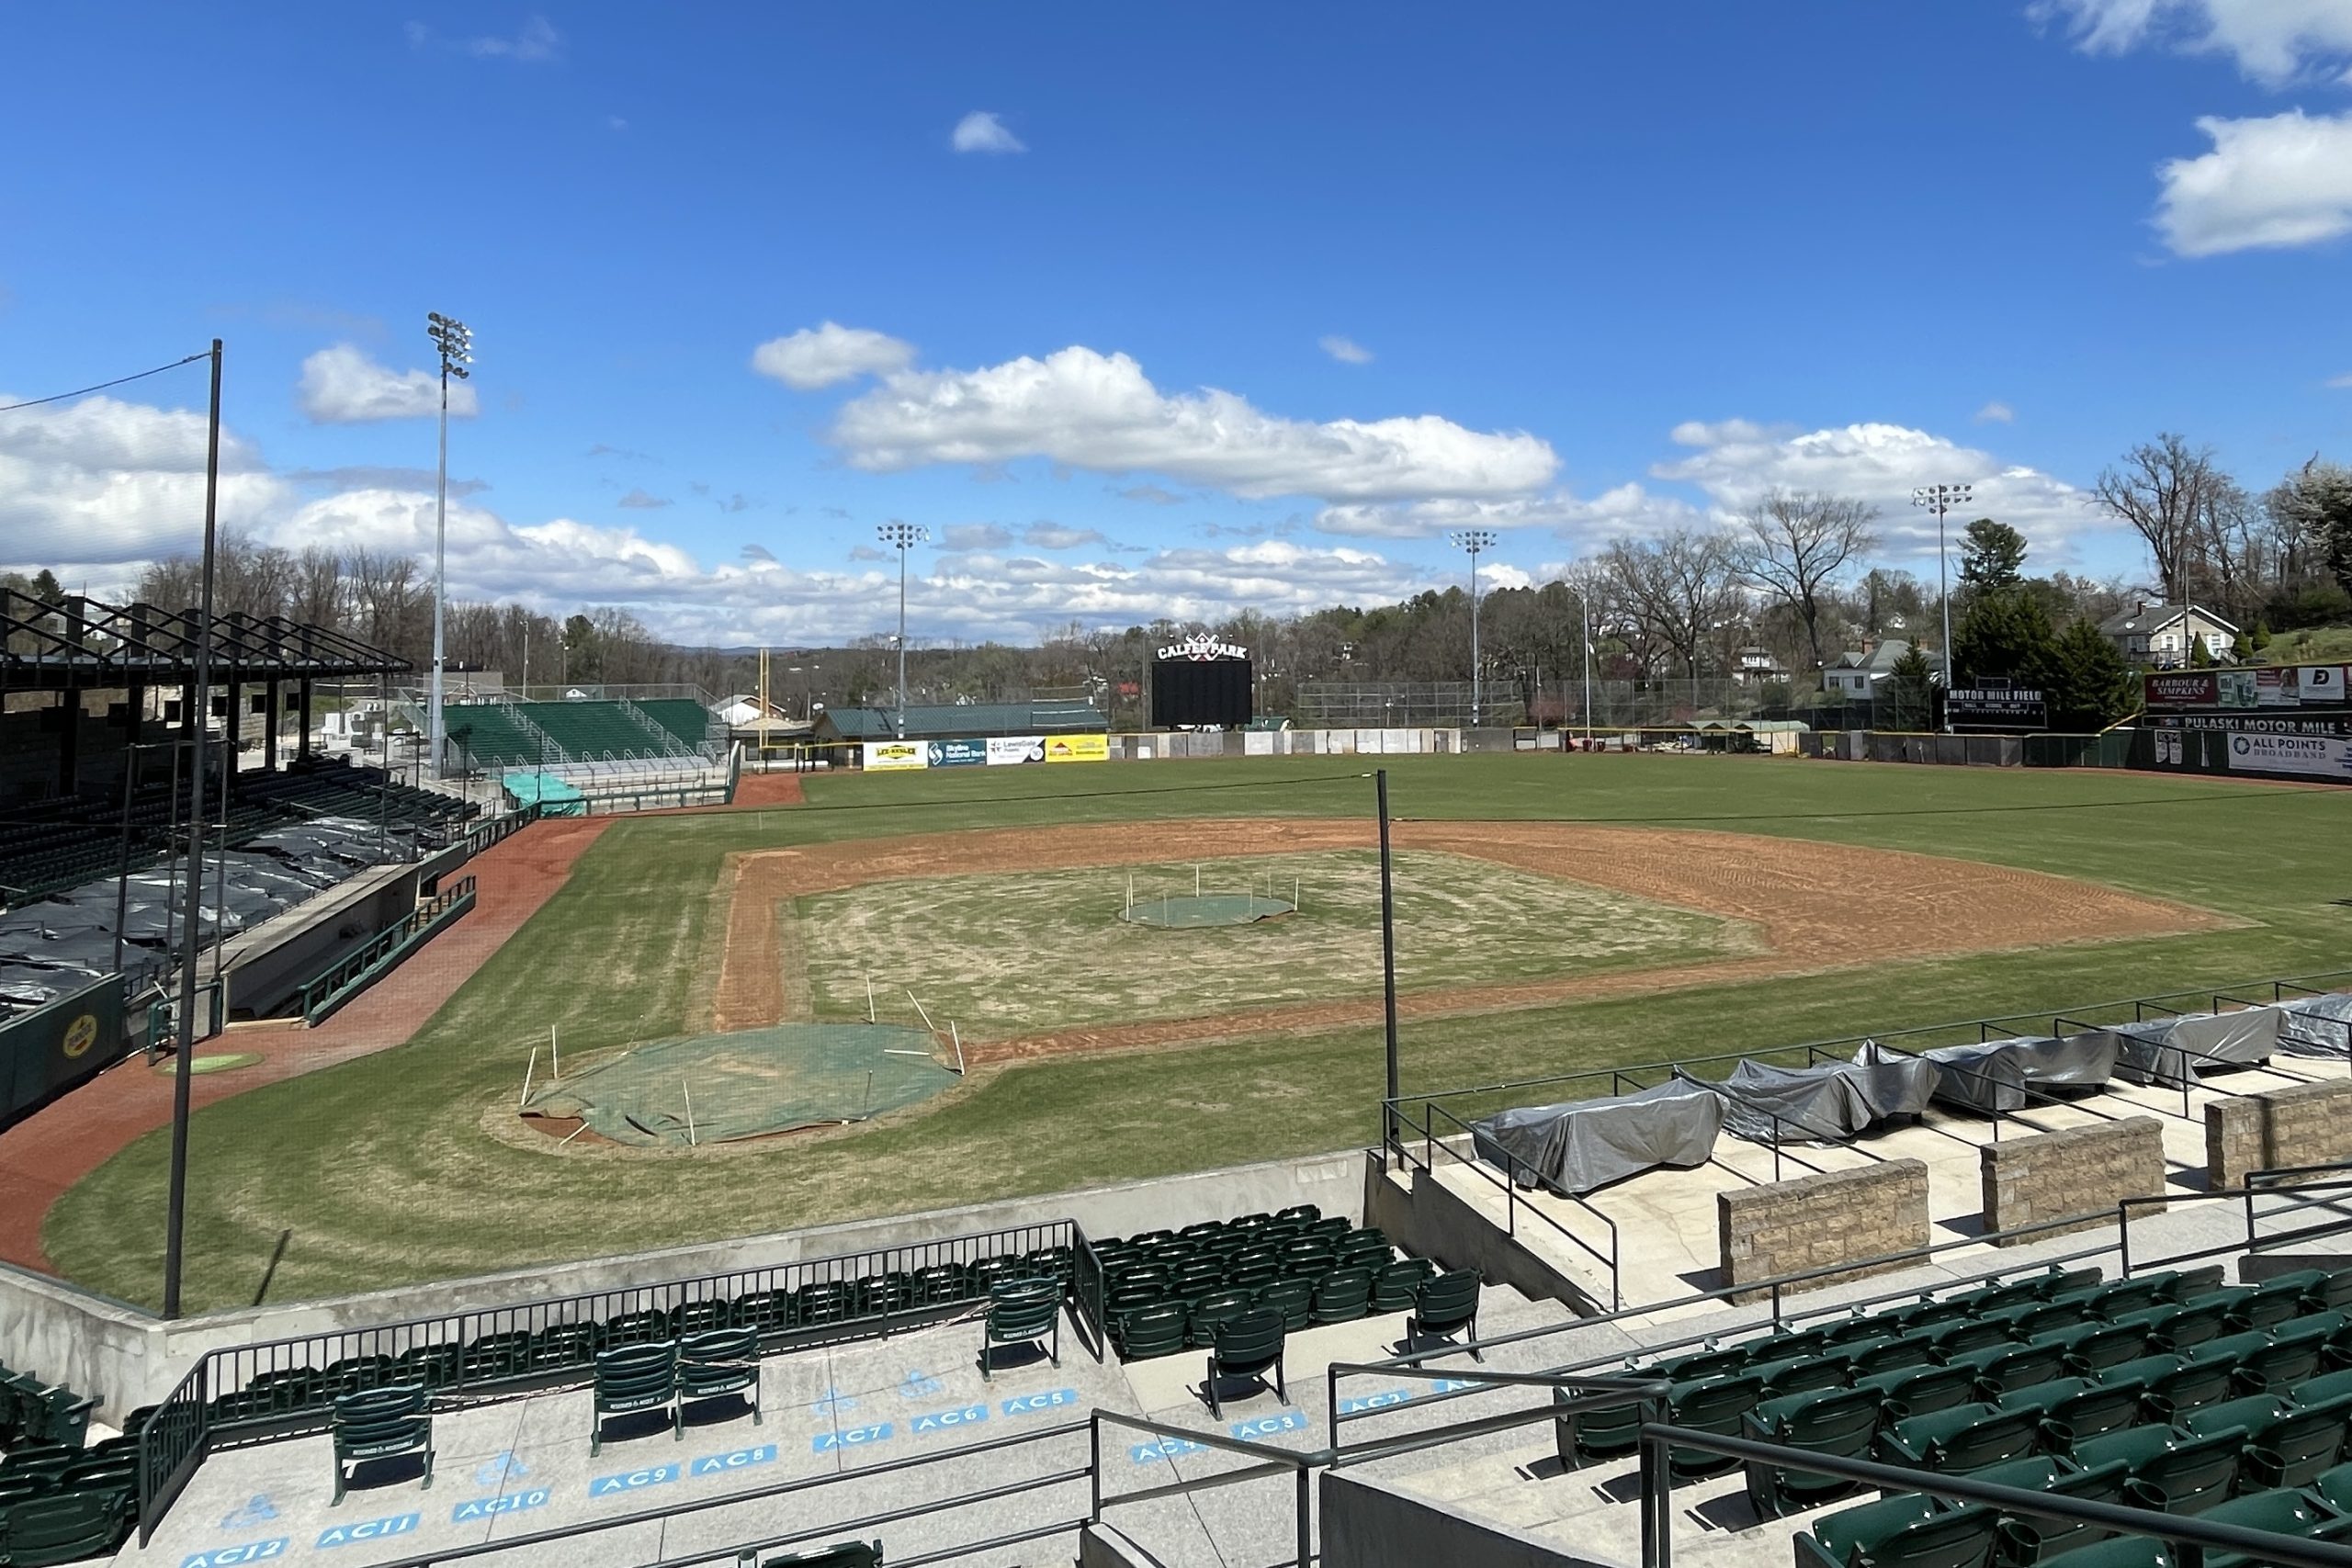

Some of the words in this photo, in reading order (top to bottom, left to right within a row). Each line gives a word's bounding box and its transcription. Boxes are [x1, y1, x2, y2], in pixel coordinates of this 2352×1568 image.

[1158, 642, 1209, 660] CALFEE
[1210, 643, 1248, 659] PARK
[2152, 679, 2199, 688] BARBOUR
[2201, 679, 2210, 688] &
[2156, 687, 2206, 695] SIMPKINS
[1949, 690, 1984, 700] MOTOR
[1986, 691, 2011, 701] MILE
[2013, 690, 2042, 702] FIELD
[2185, 717, 2239, 729] PULASKI
[2244, 719, 2297, 733] MOTOR
[2301, 722, 2335, 734] MILE
[945, 744, 969, 752] Skyline
[945, 750, 970, 759] National
[971, 750, 986, 758] Bank
[2253, 748, 2326, 760] BROADBAND
[2254, 739, 2275, 749] ALL
[2278, 739, 2326, 751] POINTS
[1010, 1393, 1064, 1413] AC5
[918, 1408, 978, 1430] AC6
[1240, 1416, 1294, 1438] AC3
[824, 1426, 882, 1448] AC7
[702, 1449, 764, 1471] AC8
[601, 1468, 667, 1493] AC9
[458, 1491, 546, 1518] AC10
[322, 1517, 410, 1544] AC11
[185, 1541, 281, 1568] AC12
